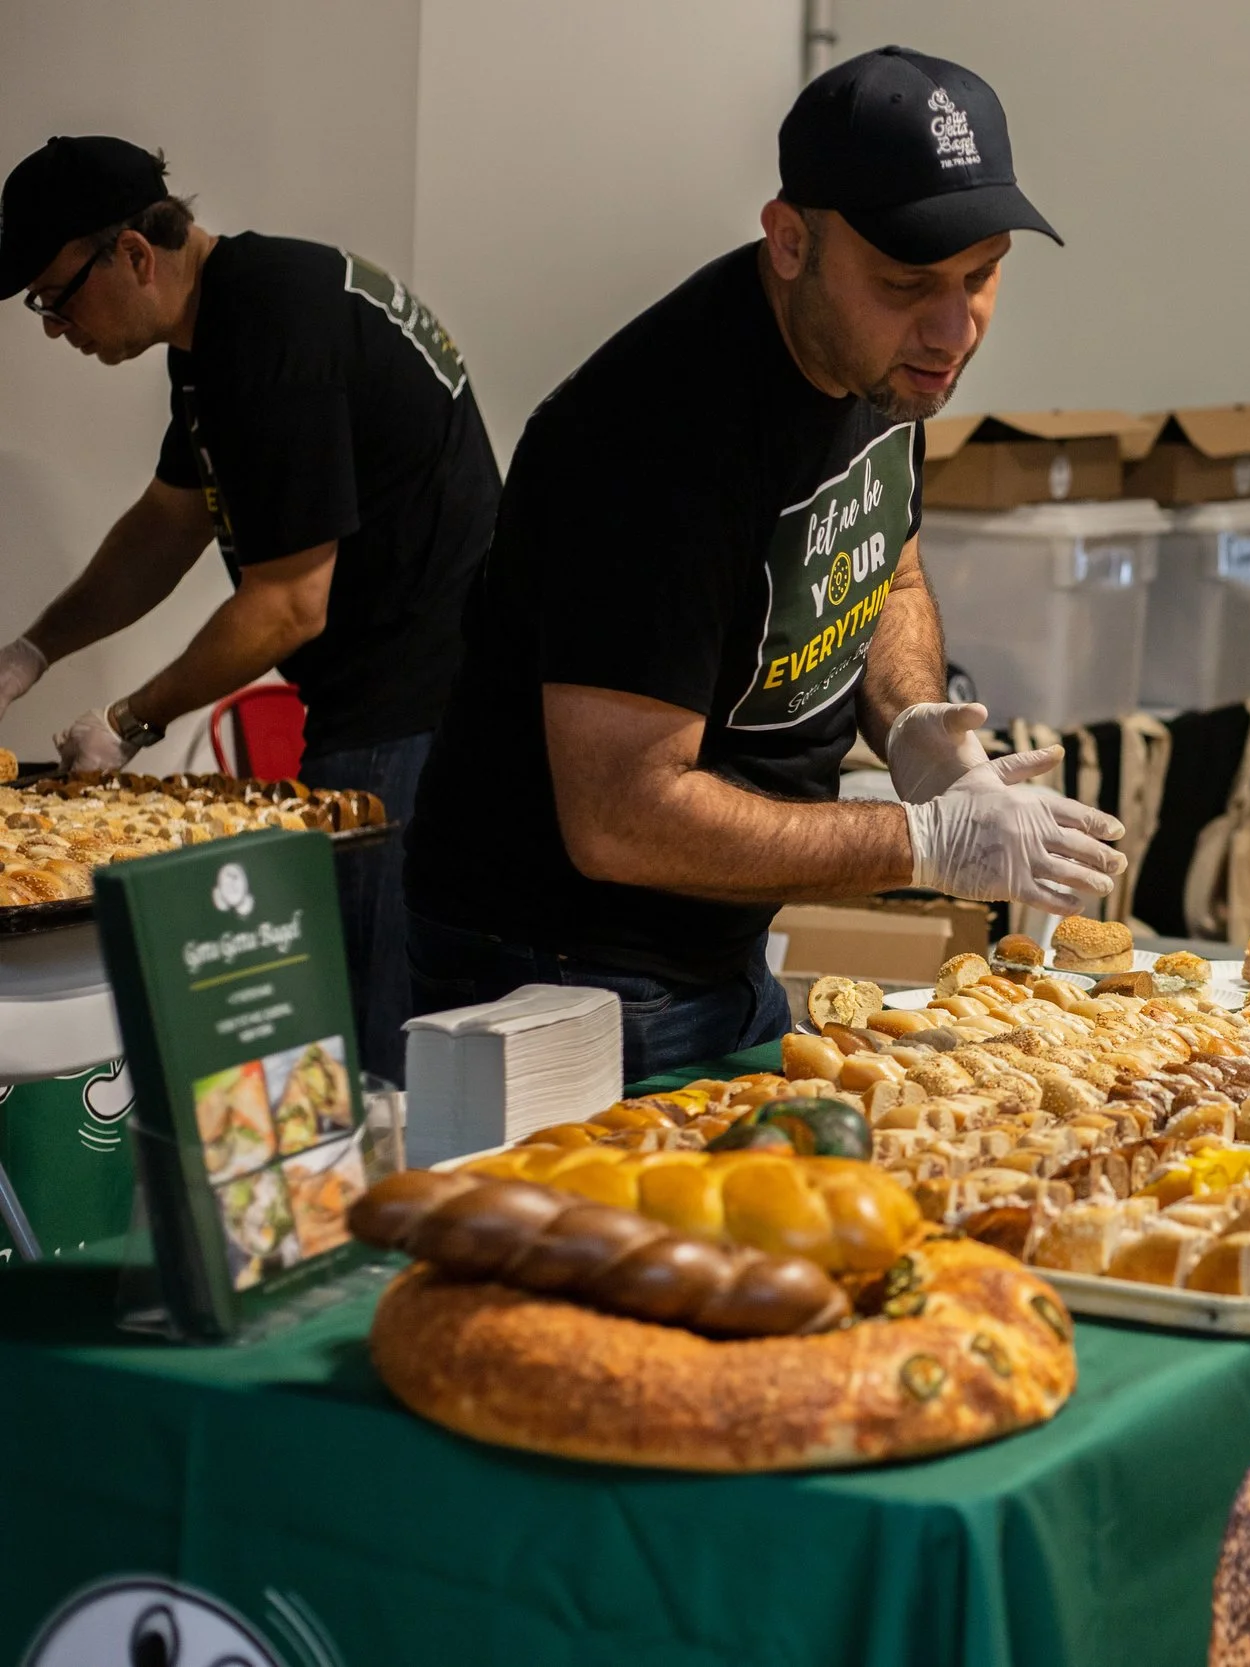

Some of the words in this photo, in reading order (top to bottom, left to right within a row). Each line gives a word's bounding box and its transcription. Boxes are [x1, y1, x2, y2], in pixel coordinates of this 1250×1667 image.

[804, 499, 838, 567] Let
[863, 457, 884, 515] be
[763, 571, 895, 691] EVERYTHIN
